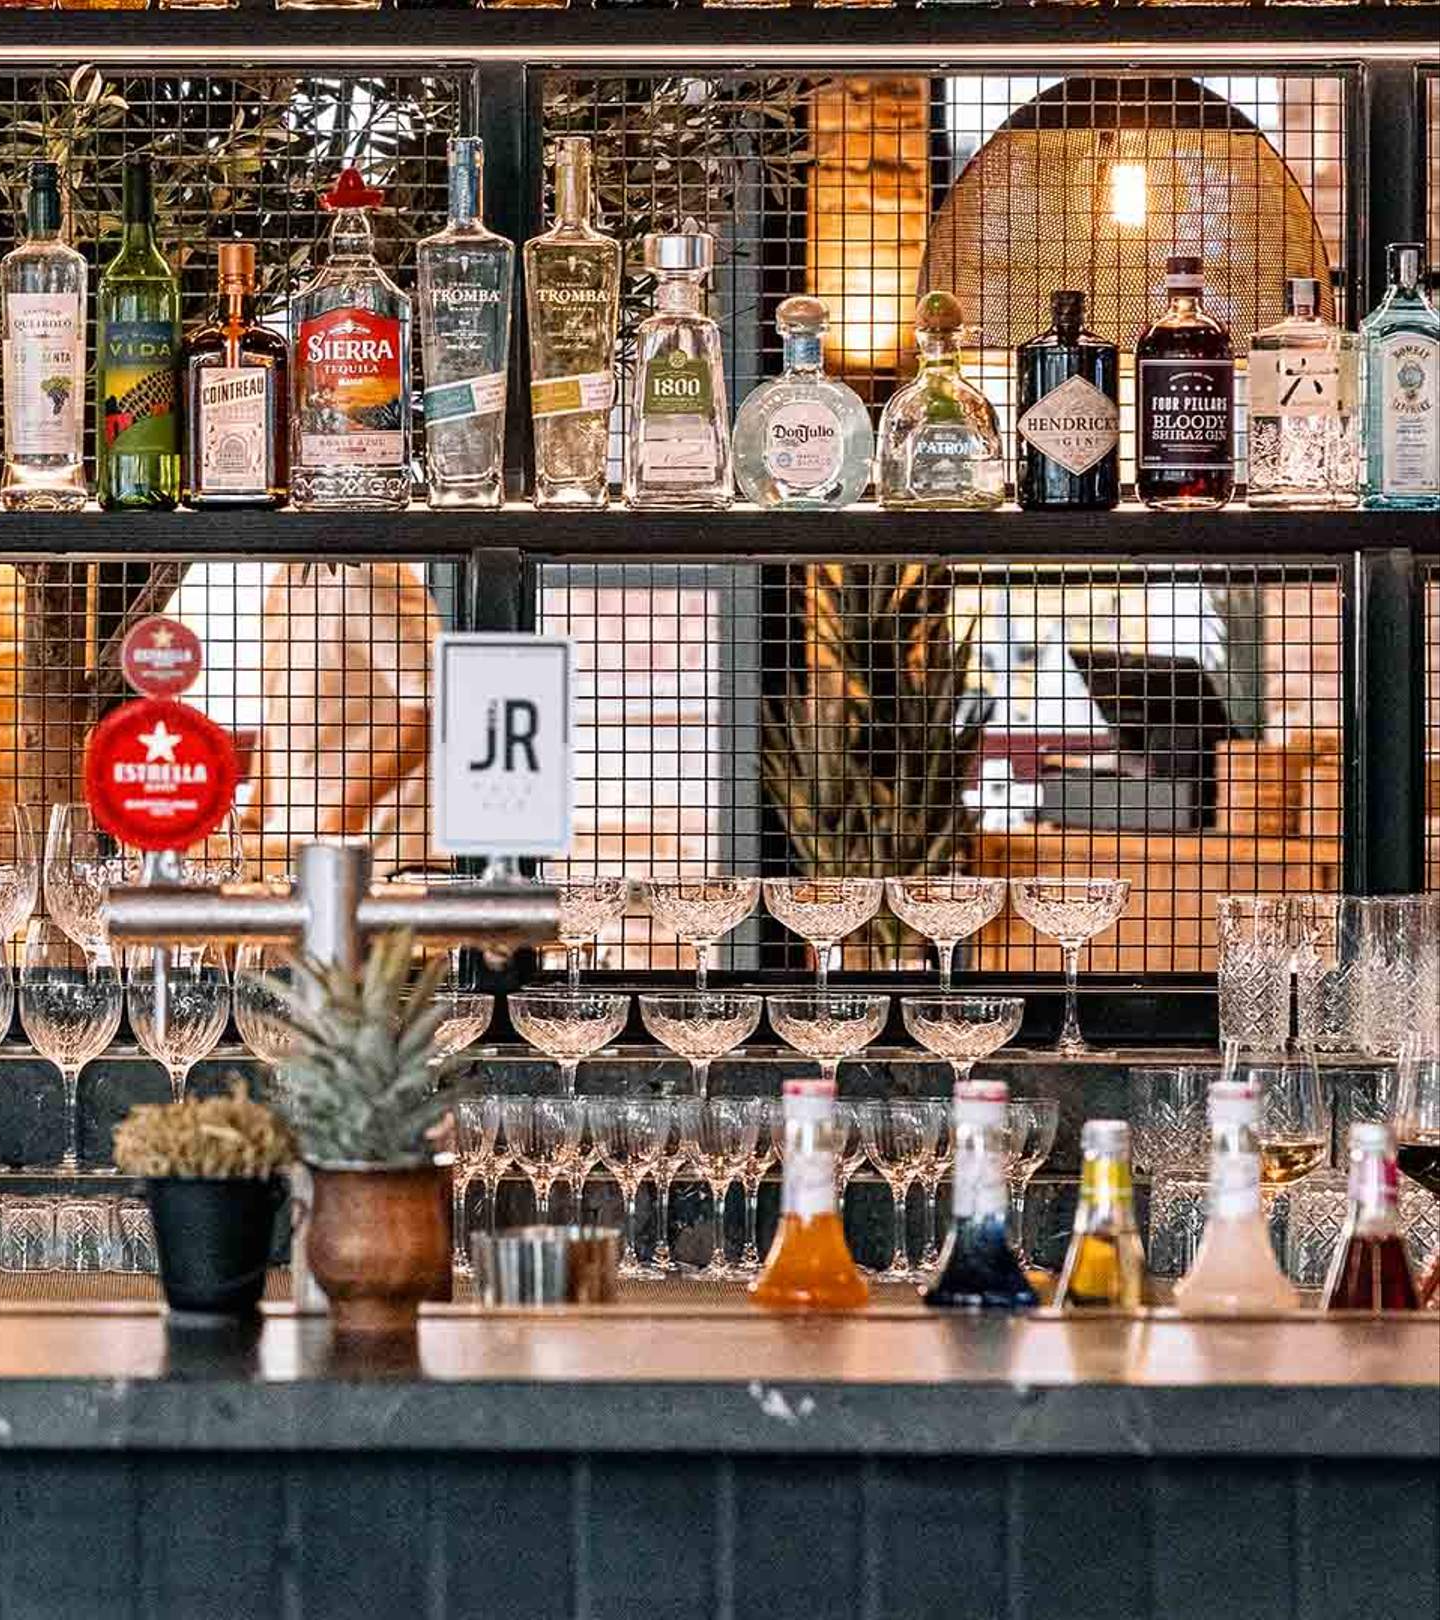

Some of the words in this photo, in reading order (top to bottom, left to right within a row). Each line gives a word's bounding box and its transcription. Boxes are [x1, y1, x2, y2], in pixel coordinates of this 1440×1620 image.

[430, 289, 501, 303] TROMBA
[536, 289, 608, 304] TROMBA
[109, 343, 172, 358] VIDA
[307, 330, 394, 363] SIERRA
[324, 364, 380, 375] TEQUILA
[202, 376, 264, 405] COINTREAU
[653, 378, 700, 397] 1800
[1152, 396, 1180, 411] FOUR
[1184, 396, 1228, 411] PILLARS
[1153, 414, 1228, 430] BLOODY
[1062, 436, 1095, 446] GIN
[1152, 430, 1203, 441] SHIRAZ
[1205, 430, 1228, 441] GIN
[113, 763, 208, 783] ESTRELLA
